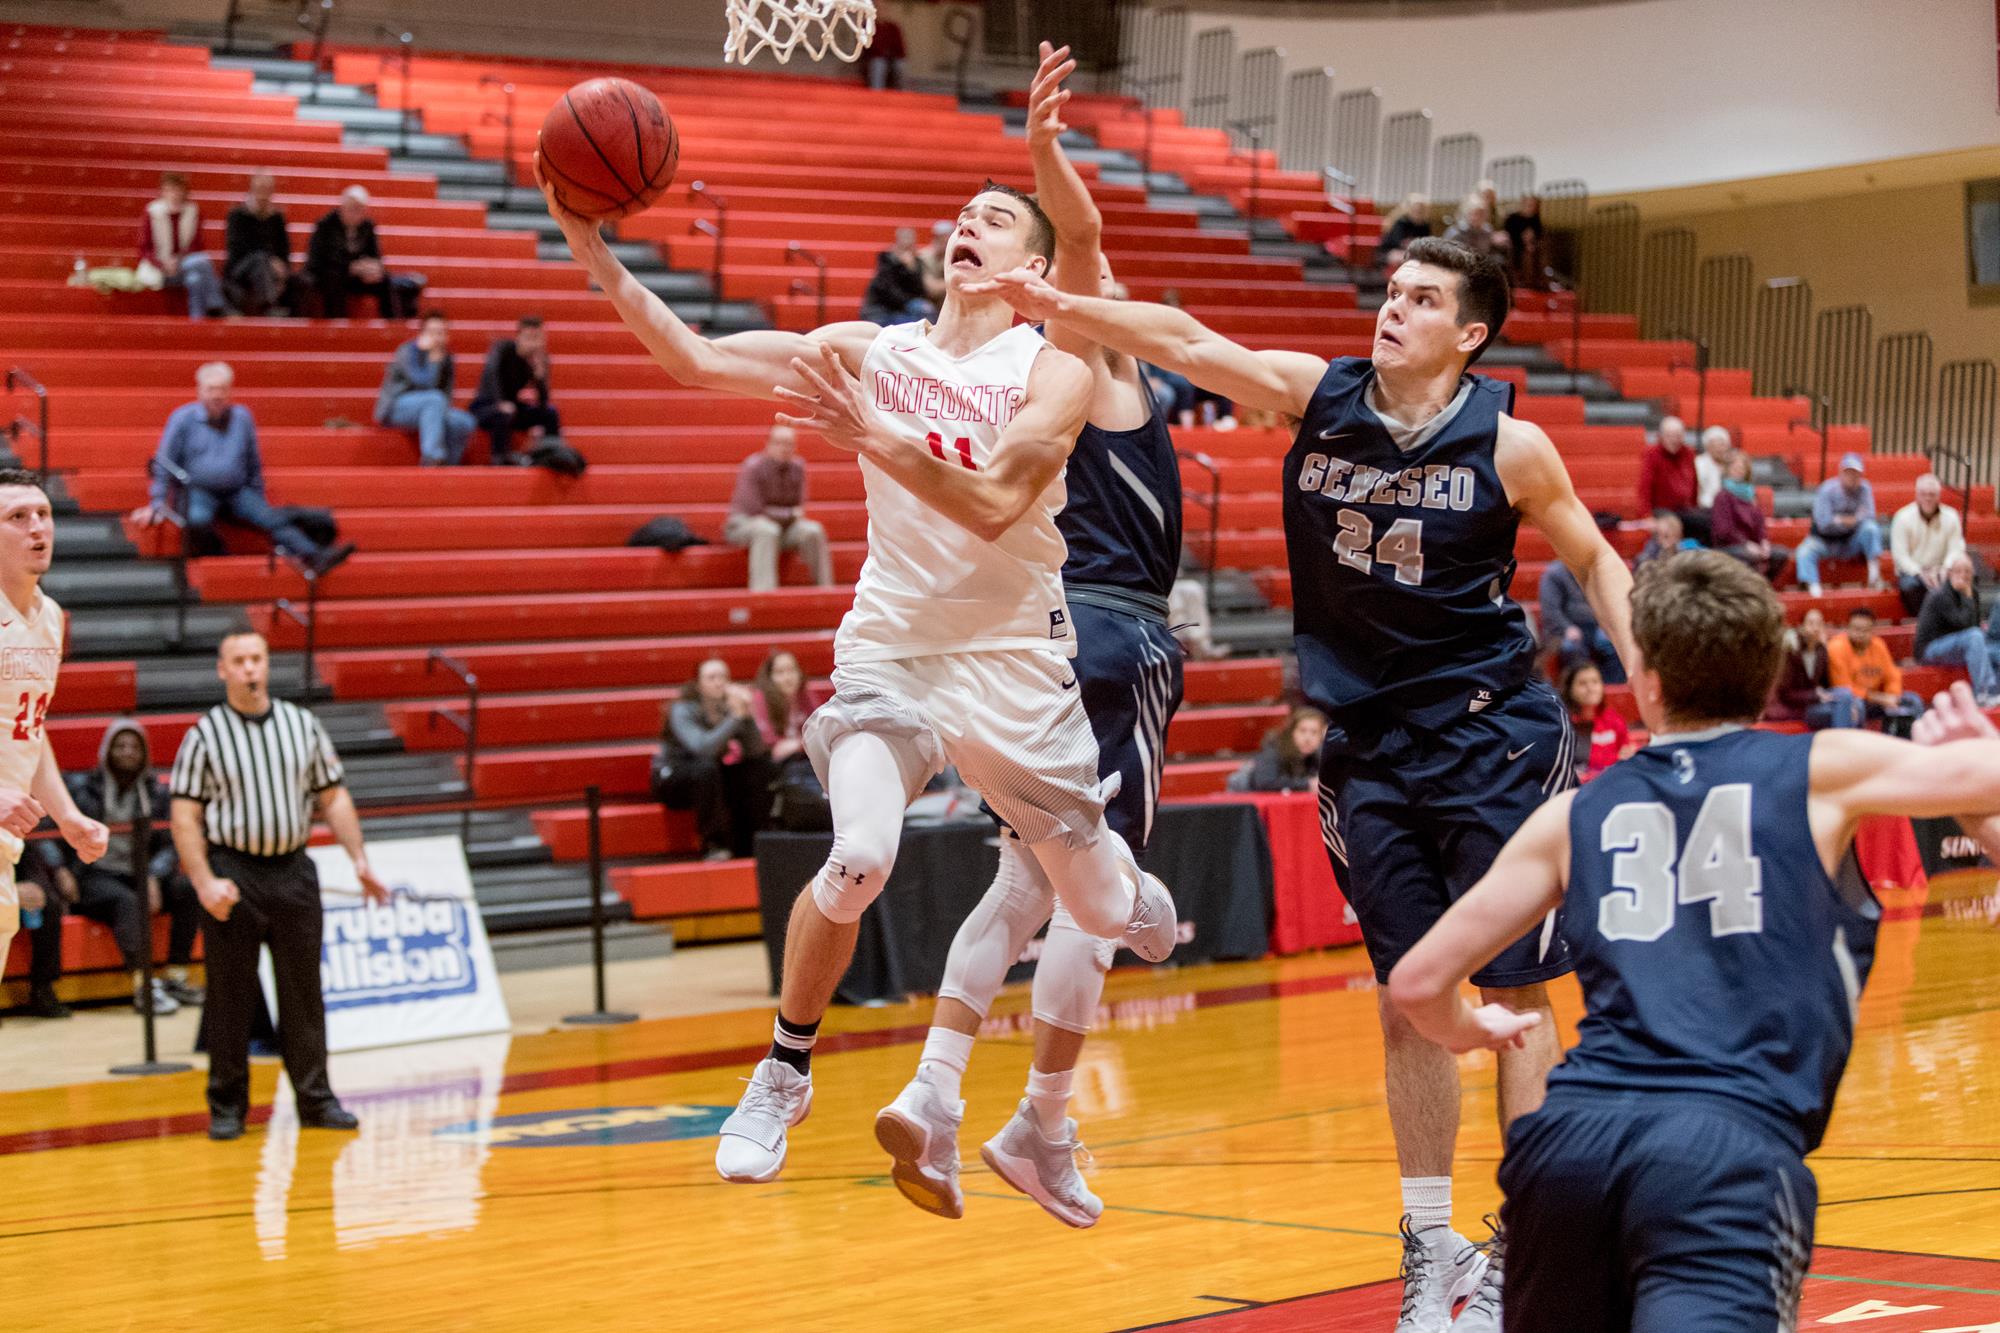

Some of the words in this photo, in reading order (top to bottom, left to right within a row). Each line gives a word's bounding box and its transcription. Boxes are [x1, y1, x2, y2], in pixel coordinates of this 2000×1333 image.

[874, 370, 1027, 428] ONEONTA
[925, 431, 977, 471] 11
[1298, 453, 1475, 512] GENESEO
[1333, 508, 1424, 586] 24
[1054, 612, 1063, 622] XL
[1477, 690, 1492, 700] XL
[1598, 783, 1763, 942] 34
[1940, 836, 1981, 860] SUN
[322, 888, 454, 943] rubba
